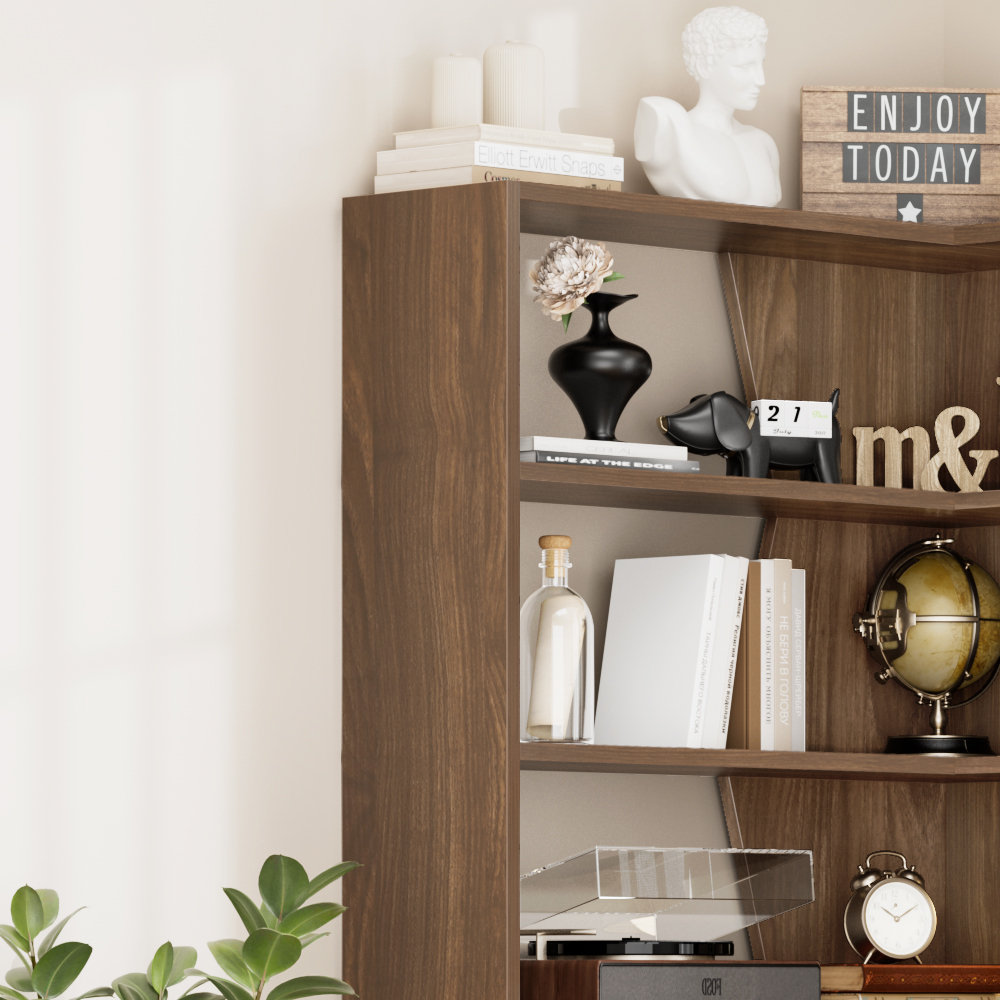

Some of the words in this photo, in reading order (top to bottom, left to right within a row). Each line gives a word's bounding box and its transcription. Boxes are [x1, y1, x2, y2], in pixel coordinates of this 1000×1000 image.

[853, 93, 982, 133] ENJOY
[478, 144, 514, 167] Elliott
[519, 150, 557, 173] Erwitt
[561, 153, 606, 177] Snaps
[847, 144, 977, 183] TODAY
[767, 405, 780, 422] 2
[793, 406, 801, 423] 1
[546, 455, 574, 464] LIFE
[579, 457, 600, 465] AT
[601, 459, 631, 468] THE
[634, 461, 674, 470] EDGE
[779, 616, 789, 631] НЕ
[779, 633, 789, 664] БЕРИ
[779, 667, 789, 676] В
[779, 678, 789, 726] ГОЛОВУ
